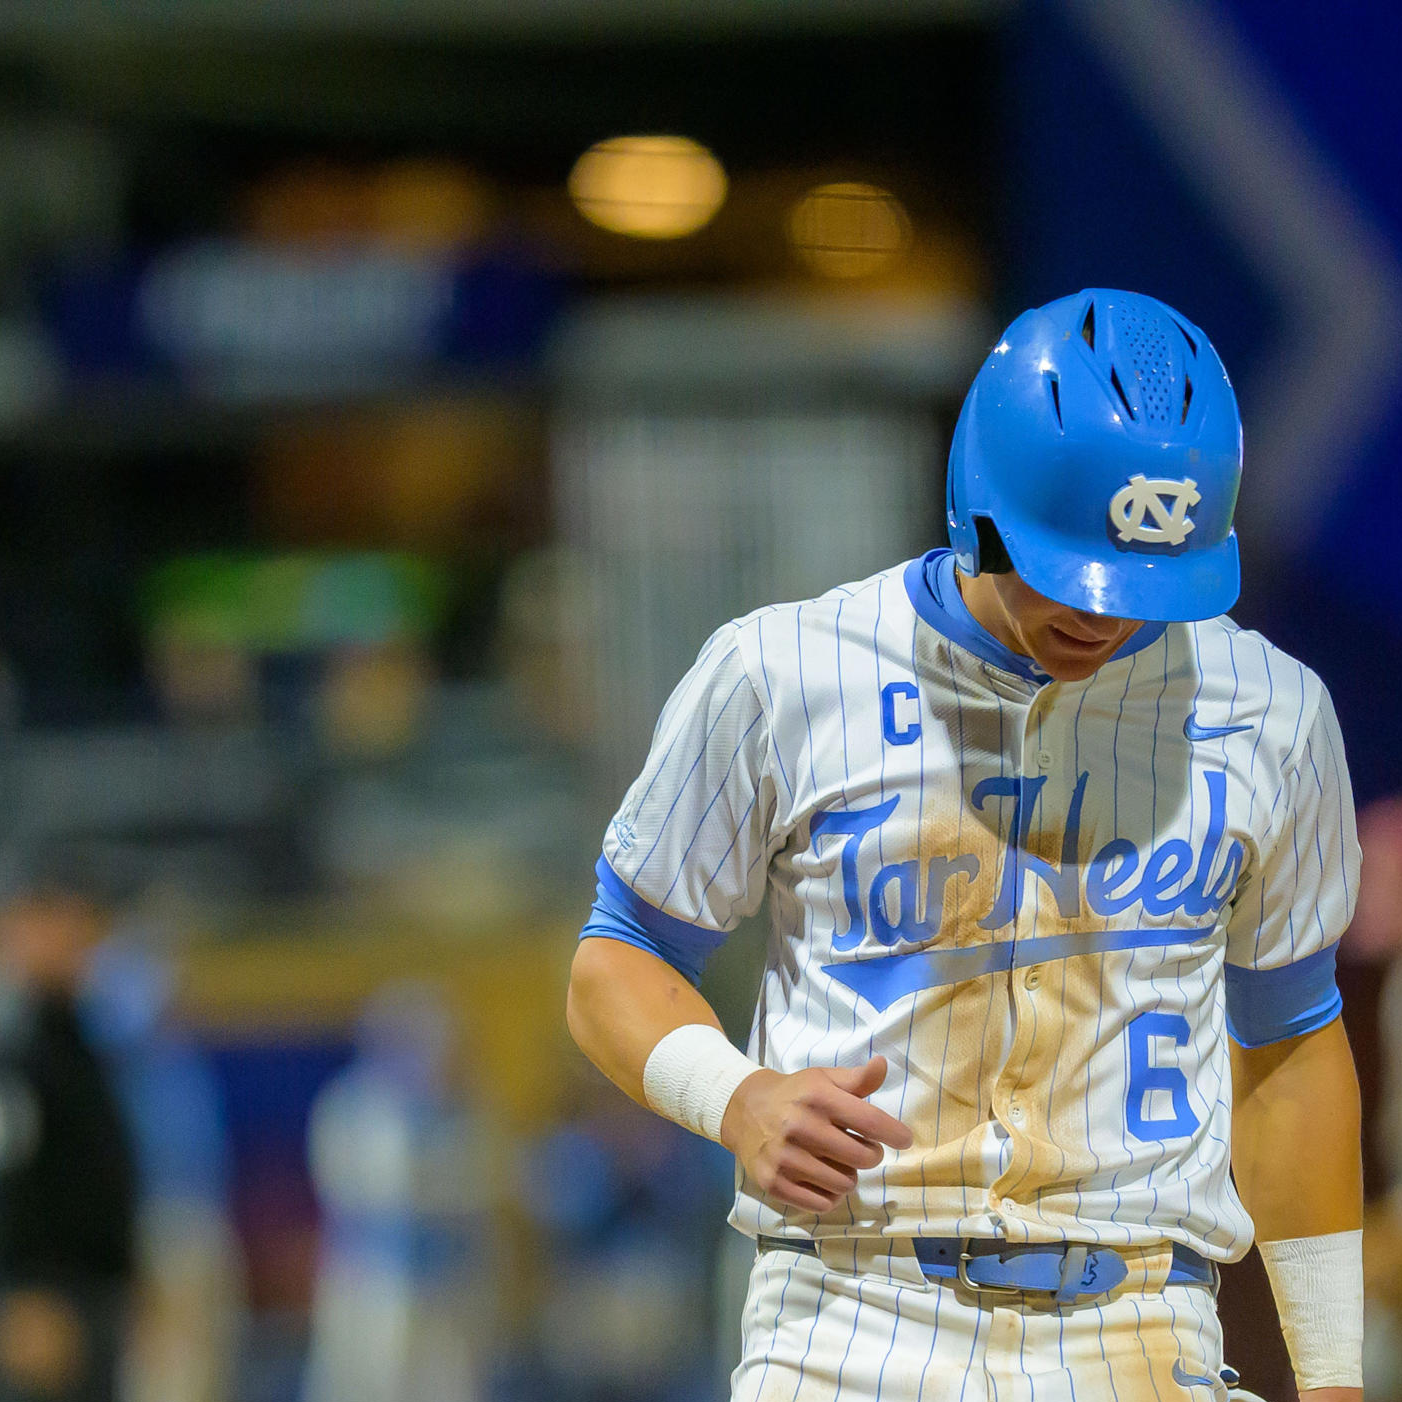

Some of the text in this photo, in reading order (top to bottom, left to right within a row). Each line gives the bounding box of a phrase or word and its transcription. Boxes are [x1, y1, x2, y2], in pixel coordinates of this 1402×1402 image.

[881, 681, 923, 746] C
[809, 771, 1244, 952] Tar Heels
[1125, 1011, 1201, 1143] 6
